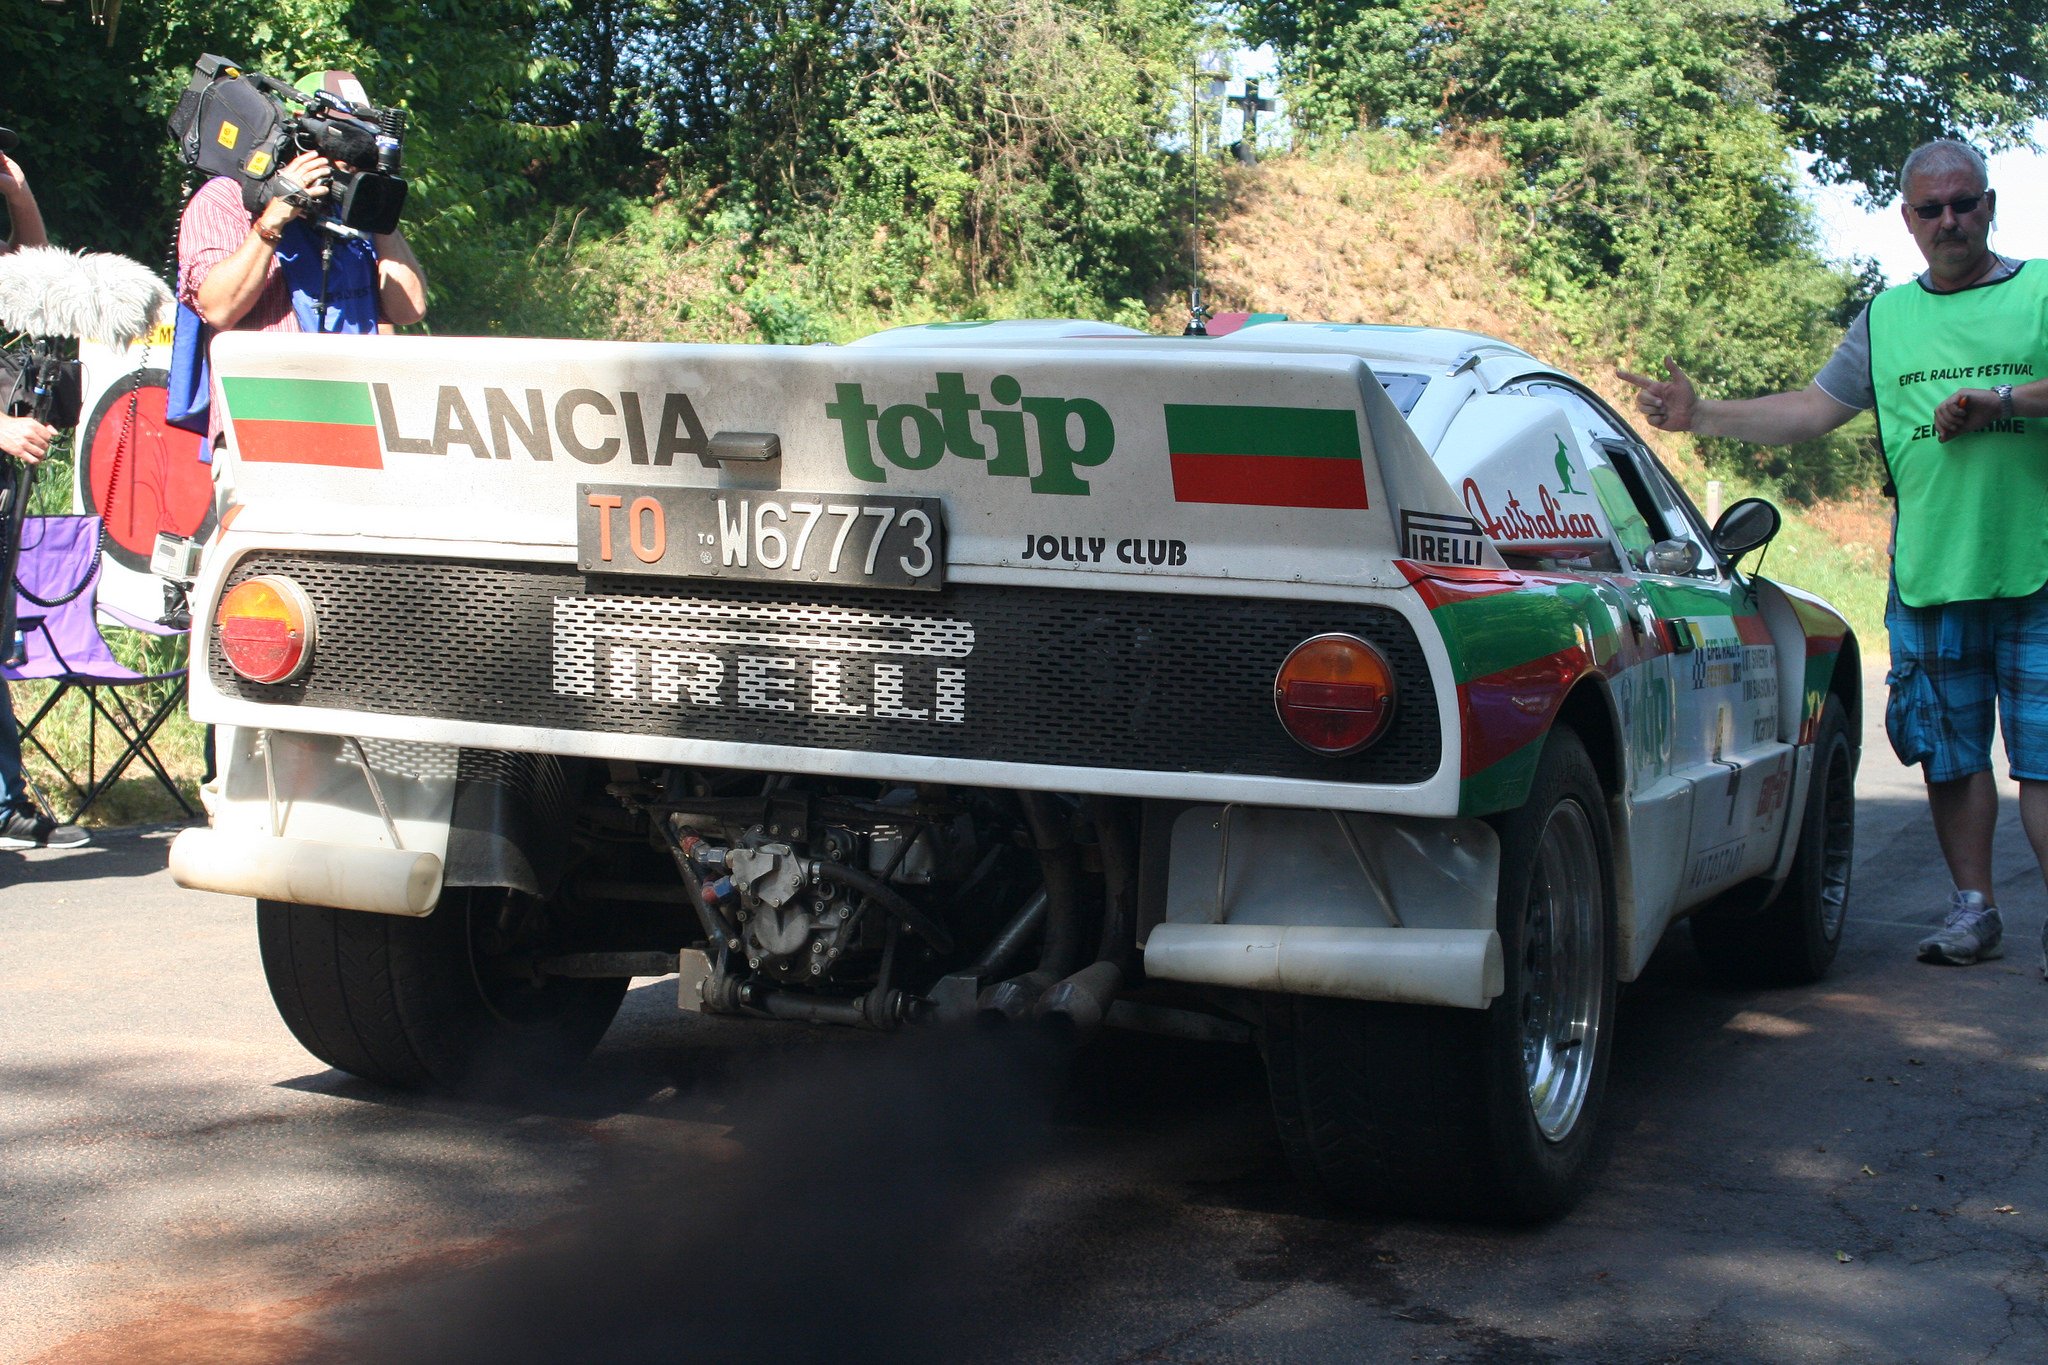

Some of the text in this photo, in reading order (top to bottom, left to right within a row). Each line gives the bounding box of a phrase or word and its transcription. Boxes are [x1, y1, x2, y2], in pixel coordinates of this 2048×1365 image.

[1899, 363, 2034, 387] EIFEL RALLYE FESTIVAL
[373, 382, 721, 468] LANCIA
[825, 372, 1115, 496] totip
[588, 494, 933, 578] TO TO W67773
[1400, 508, 1483, 566] PIRELLI
[1462, 477, 1603, 541] Australian
[1022, 534, 1187, 566] JOLLY CLUB
[553, 596, 975, 723] PIRELLI
